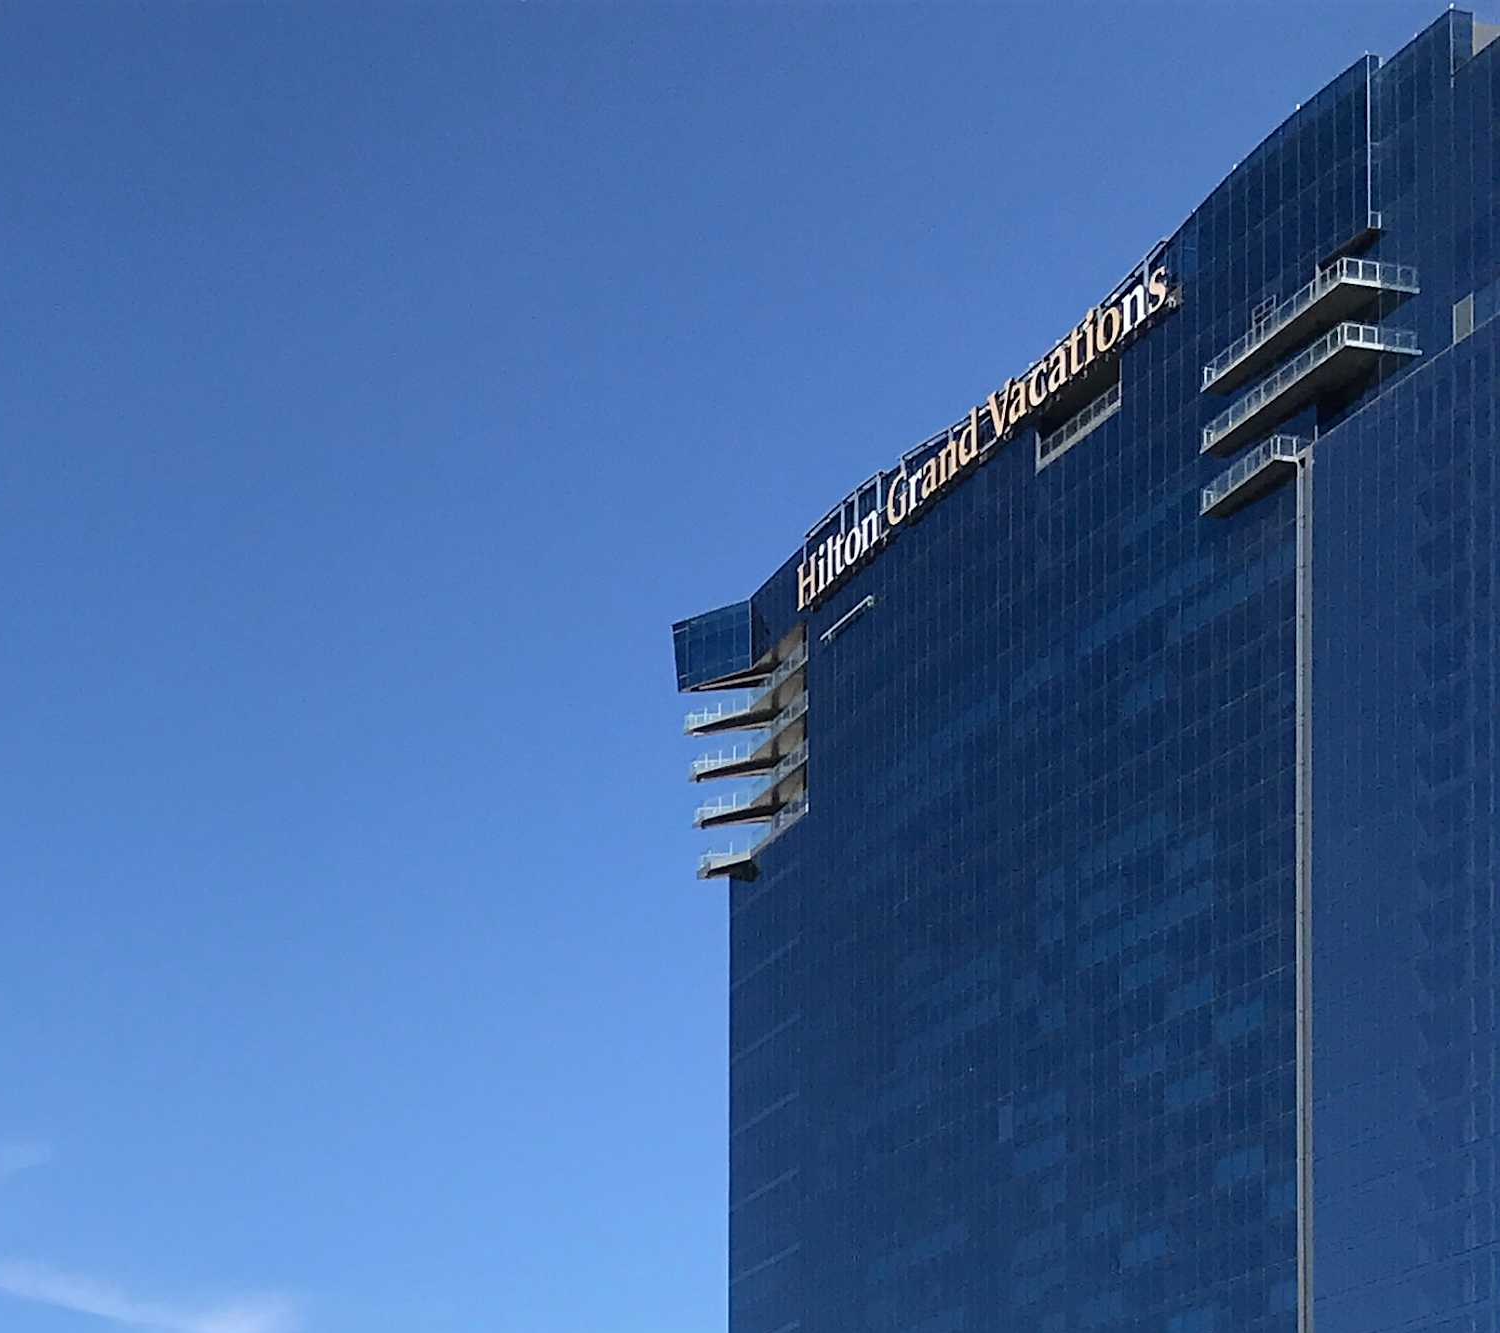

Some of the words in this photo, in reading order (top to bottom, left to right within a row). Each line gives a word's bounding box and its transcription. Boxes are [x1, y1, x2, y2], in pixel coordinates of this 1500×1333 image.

[797, 510, 879, 612] Hilton
[887, 406, 979, 527] Grand
[987, 264, 1170, 438] Vacations
